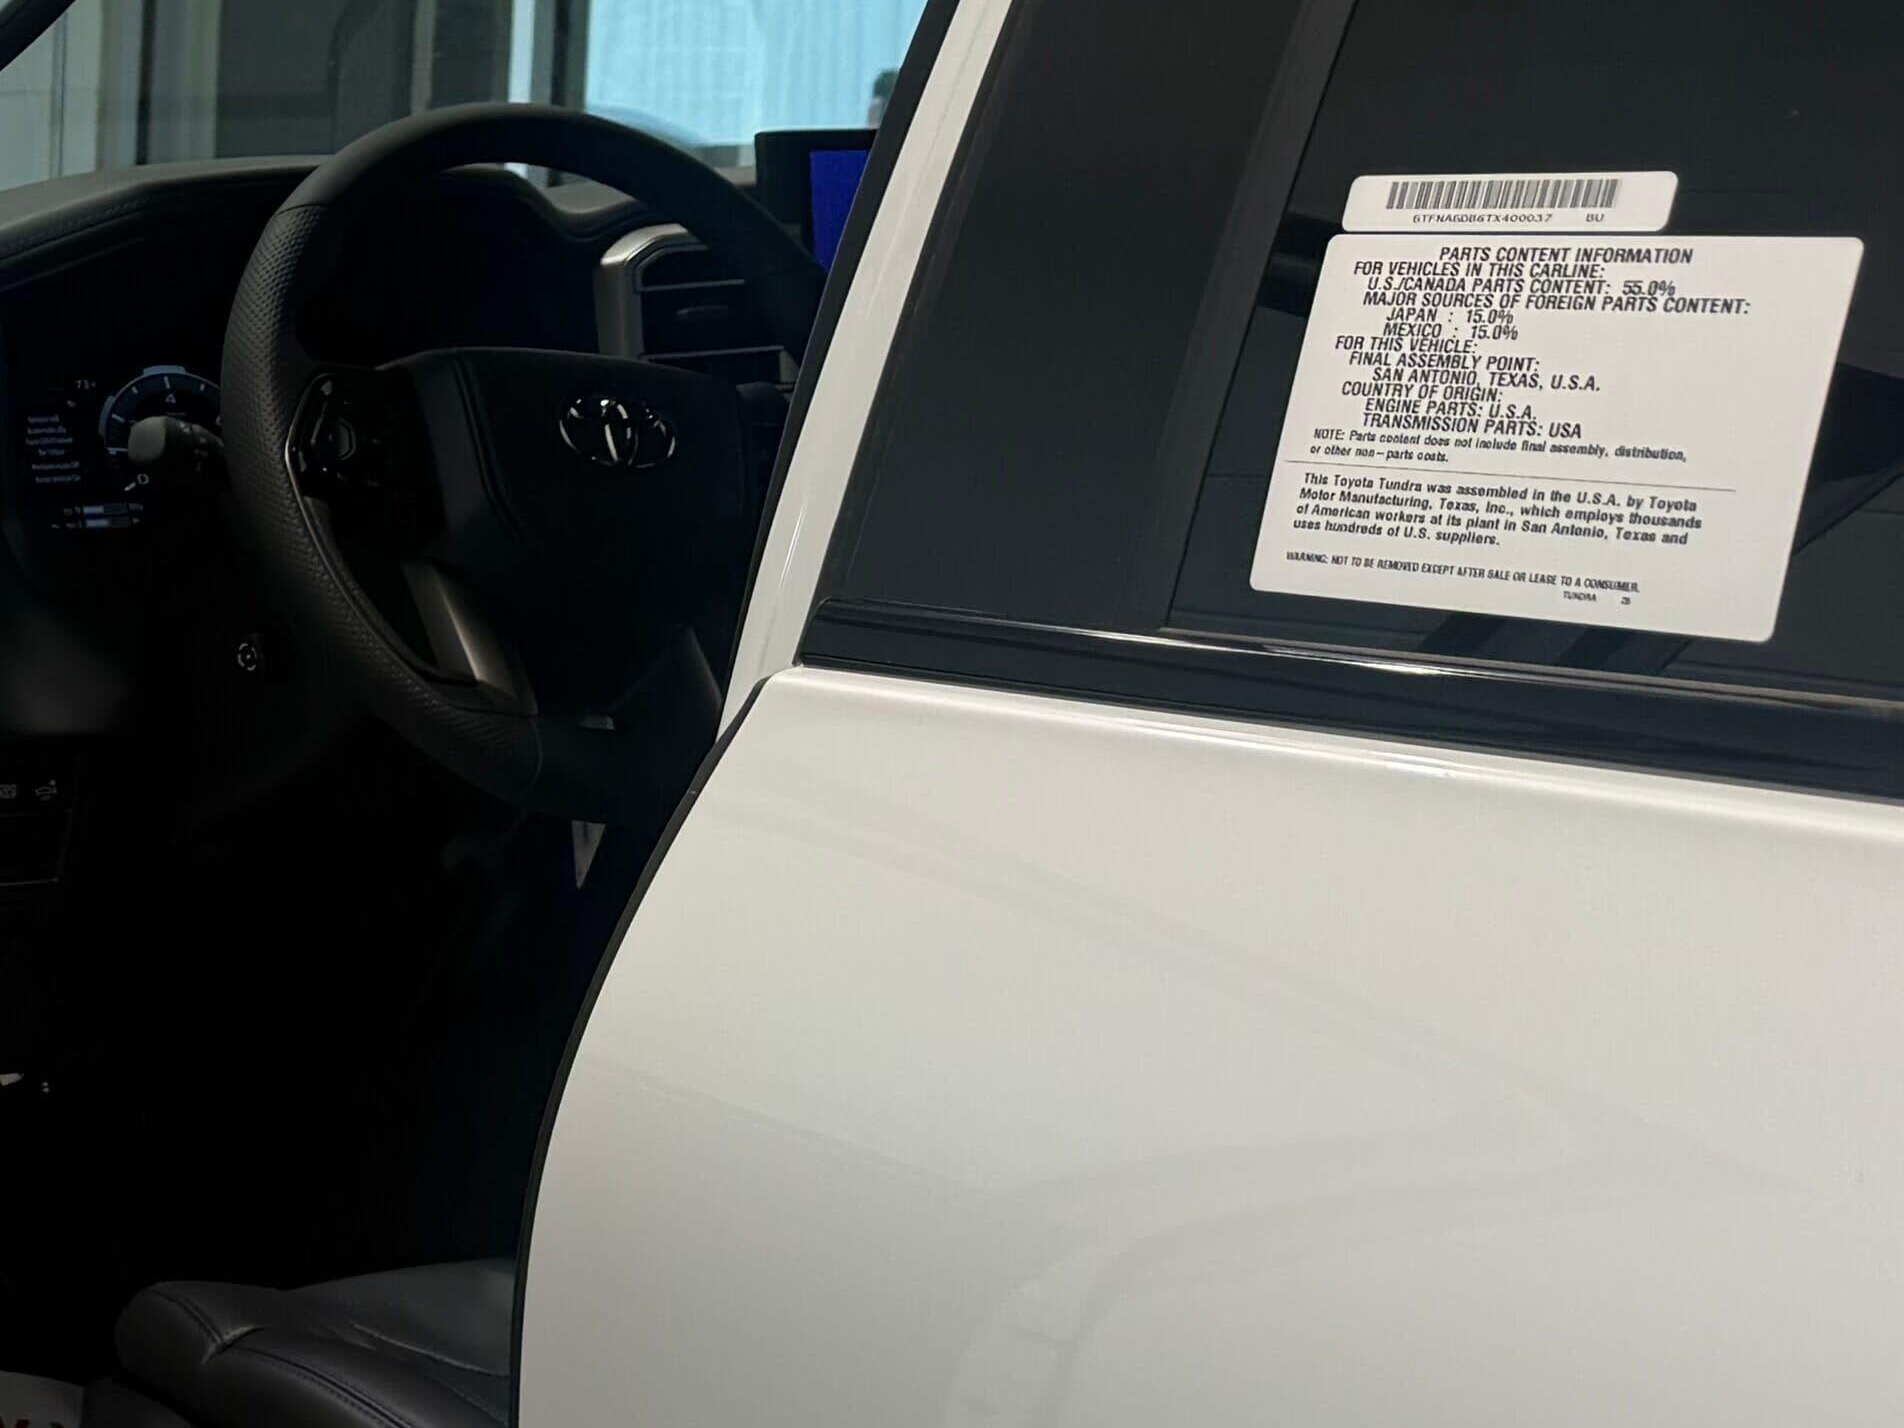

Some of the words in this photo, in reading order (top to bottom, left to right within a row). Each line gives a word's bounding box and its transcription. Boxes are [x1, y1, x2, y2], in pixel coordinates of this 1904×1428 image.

[1439, 246, 1492, 262] PARTS
[1496, 246, 1572, 262] CONTENT
[1574, 247, 1693, 264] INFORMATION
[1354, 261, 1384, 275] FOR
[1388, 261, 1461, 276] VEHICLES
[1465, 262, 1483, 276] IN
[1489, 262, 1525, 277] THIS
[1529, 262, 1605, 278] CARLINE:
[1367, 276, 1468, 293] U.S./CANADA
[1470, 278, 1525, 294] PARTS
[1530, 278, 1611, 295] CONTENT:
[1622, 280, 1676, 296] 55.0%
[1363, 291, 1418, 308] MAJOR
[1421, 292, 1496, 308] SOURCES
[1498, 294, 1522, 310] OF
[1525, 294, 1596, 311] FOREIGN
[1601, 296, 1658, 312] PARTS
[1663, 298, 1750, 314] CONTENT:
[1386, 308, 1437, 323] JAPAN
[1467, 309, 1514, 324] 15.0%
[1383, 323, 1442, 338] MEXICO
[1470, 325, 1518, 340] 15.0%
[1335, 335, 1365, 351] FOR
[1370, 336, 1404, 352] THIS
[1410, 337, 1482, 354] VEHICLE:
[1349, 352, 1392, 368] FINAL
[1396, 353, 1482, 370] ASSEMBLY
[1486, 356, 1540, 372] POINT:
[1372, 368, 1404, 382] SAN
[1408, 370, 1480, 387] ANTONIO,
[1488, 372, 1543, 390] TEXAS,
[1550, 374, 1600, 391] U.S.A.
[1342, 382, 1414, 400] COUNTRY
[1416, 385, 1439, 401] OF
[1442, 386, 1503, 404] ORIGIN:
[1364, 398, 1422, 415] ENGINE
[1425, 400, 1483, 418] PARTS:
[1488, 404, 1536, 420] U.S.A.
[1363, 412, 1480, 434] TRANSMISSION
[1484, 419, 1543, 436] PARTS:
[1548, 422, 1581, 439] USA
[1305, 472, 1328, 485] This
[1334, 474, 1374, 489] Toyota
[1379, 477, 1422, 492] Tundra
[1427, 484, 1452, 494] was
[1456, 486, 1528, 500] assembled
[1532, 488, 1545, 502] in
[1550, 490, 1571, 503] the
[1576, 492, 1621, 507] U.S.A.
[1626, 495, 1644, 509] by
[1650, 496, 1697, 512] Toyota
[1299, 487, 1336, 501] Motor
[1338, 489, 1432, 510] Manufacturing,
[1440, 497, 1479, 514] Texas,
[1485, 500, 1514, 516] Inc.,
[1520, 504, 1560, 518] which
[1565, 508, 1624, 523] employs
[1629, 509, 1702, 529] thousands
[1293, 520, 1321, 530] uses
[1324, 520, 1383, 536] hundreds
[1386, 525, 1400, 537] of
[1404, 526, 1430, 540] U.S.
[1435, 530, 1500, 546] suppliers.
[1296, 503, 1310, 515] of
[1310, 504, 1370, 522] American
[1375, 510, 1426, 526] workers
[1430, 514, 1443, 526] at
[1446, 514, 1462, 527] its
[1465, 516, 1500, 530] plant
[1504, 518, 1516, 532] in
[1521, 520, 1547, 534] San
[1550, 522, 1612, 540] Antonio,
[1616, 526, 1656, 542] Texas
[1661, 532, 1688, 545] and
